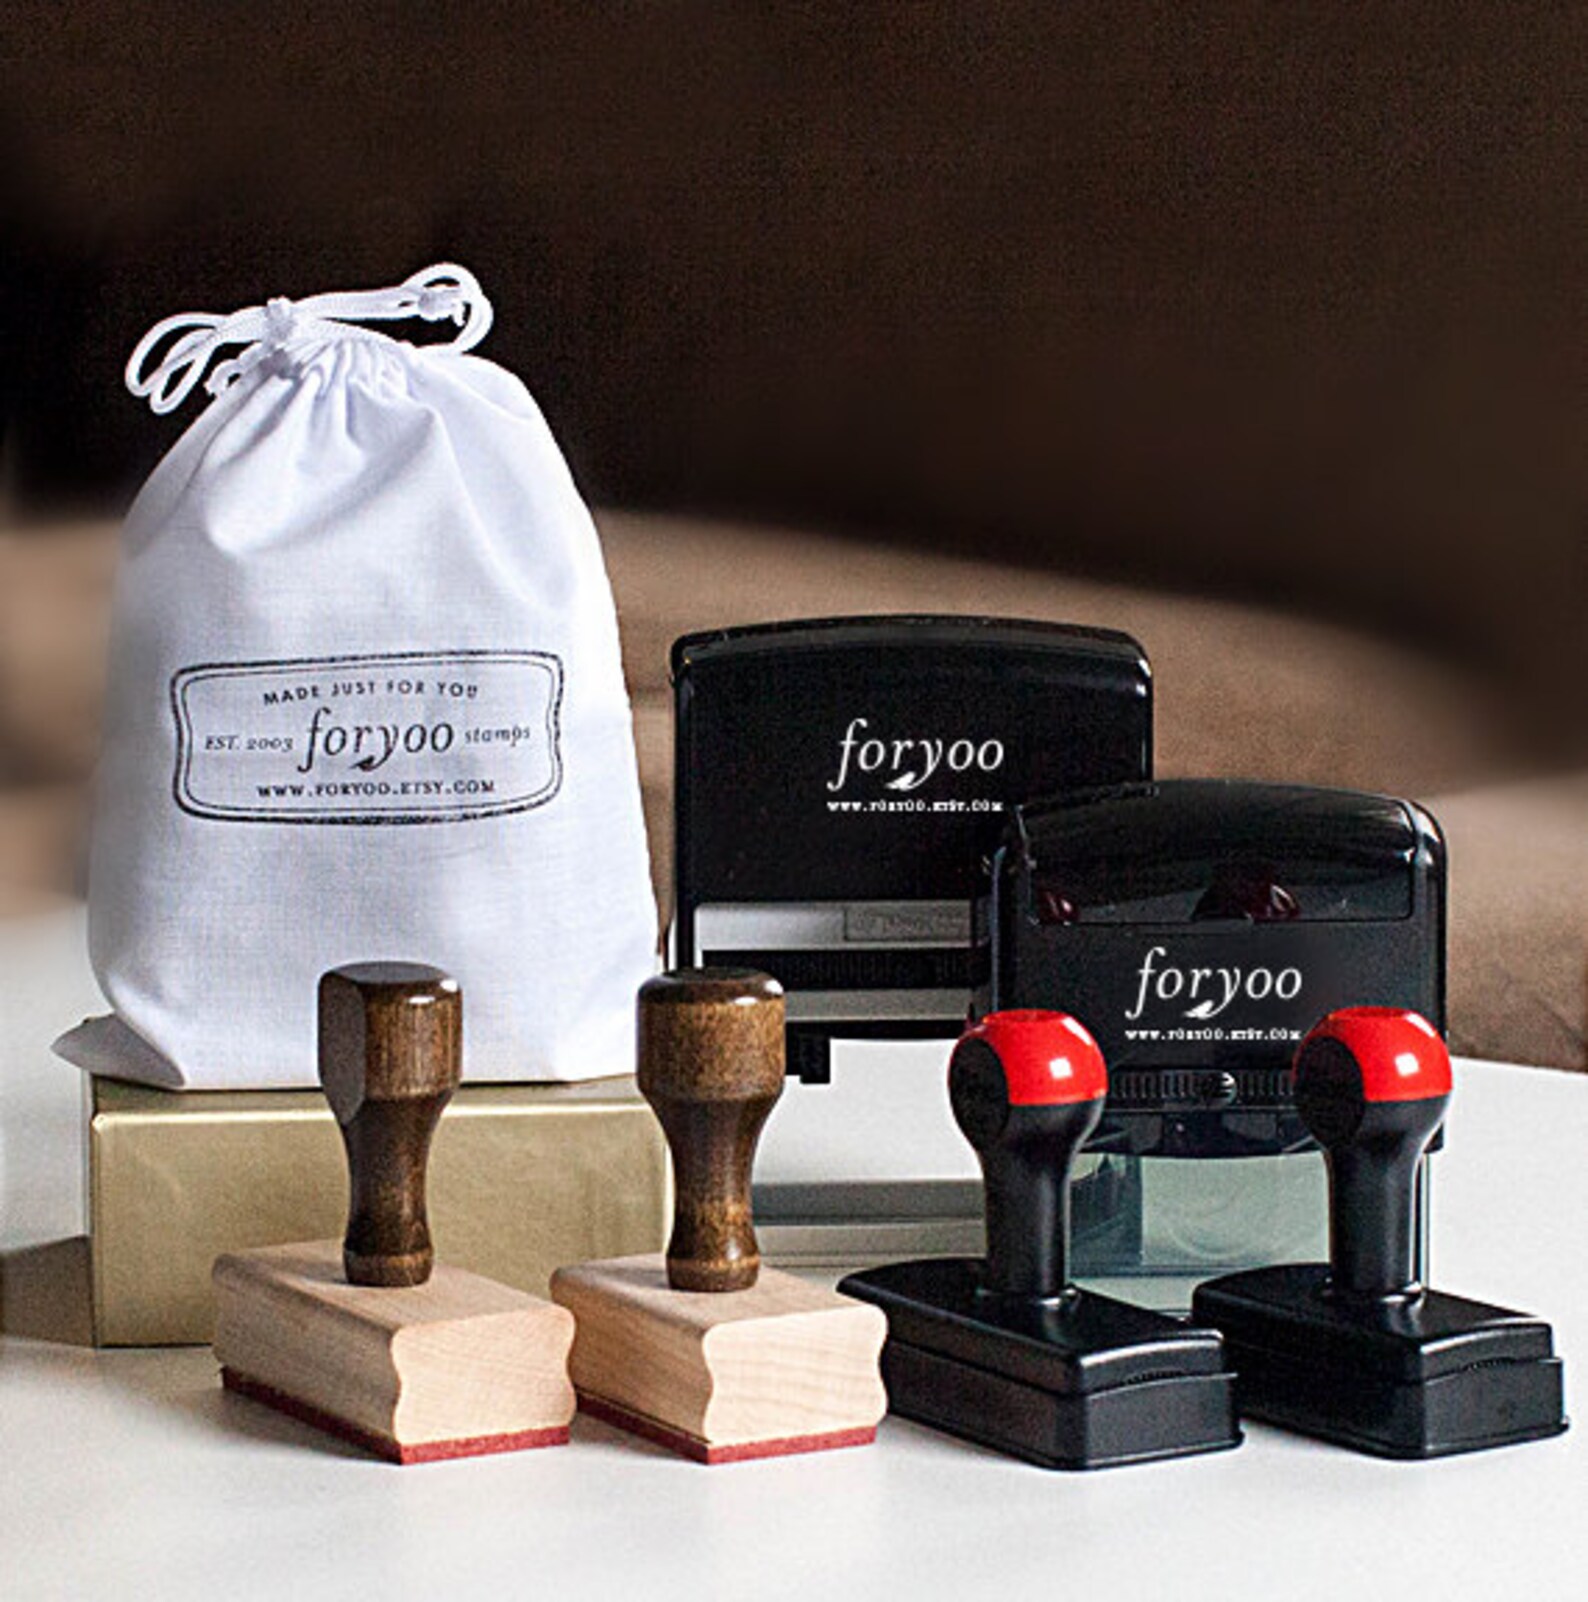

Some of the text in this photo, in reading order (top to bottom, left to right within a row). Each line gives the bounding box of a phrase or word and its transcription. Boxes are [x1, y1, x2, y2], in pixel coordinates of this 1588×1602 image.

[263, 681, 478, 706] MADE JUST FOR YOU
[204, 707, 531, 774] EST. 2003 foryoo stamps
[826, 717, 1005, 792] foryoo
[1124, 946, 1302, 1020] foryoo
